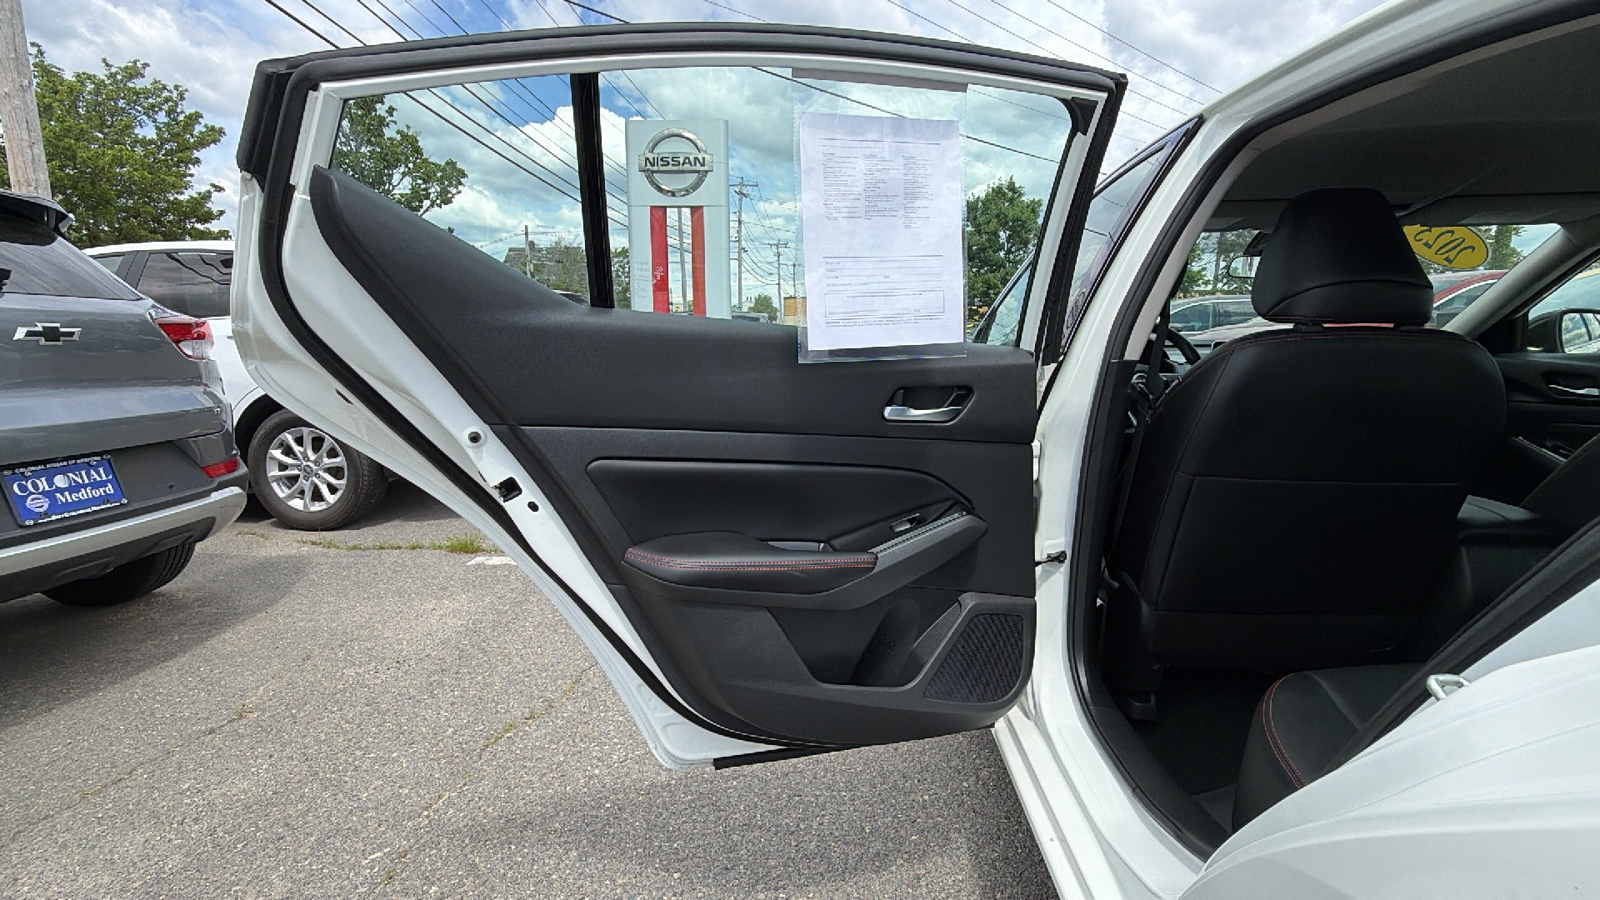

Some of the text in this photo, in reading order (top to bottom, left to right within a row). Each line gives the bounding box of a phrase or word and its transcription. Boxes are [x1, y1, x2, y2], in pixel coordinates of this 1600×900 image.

[644, 156, 706, 168] NISSAN
[15, 464, 46, 473] COLONIAL
[13, 467, 112, 496] COLONIAL
[55, 483, 115, 505] Medford
